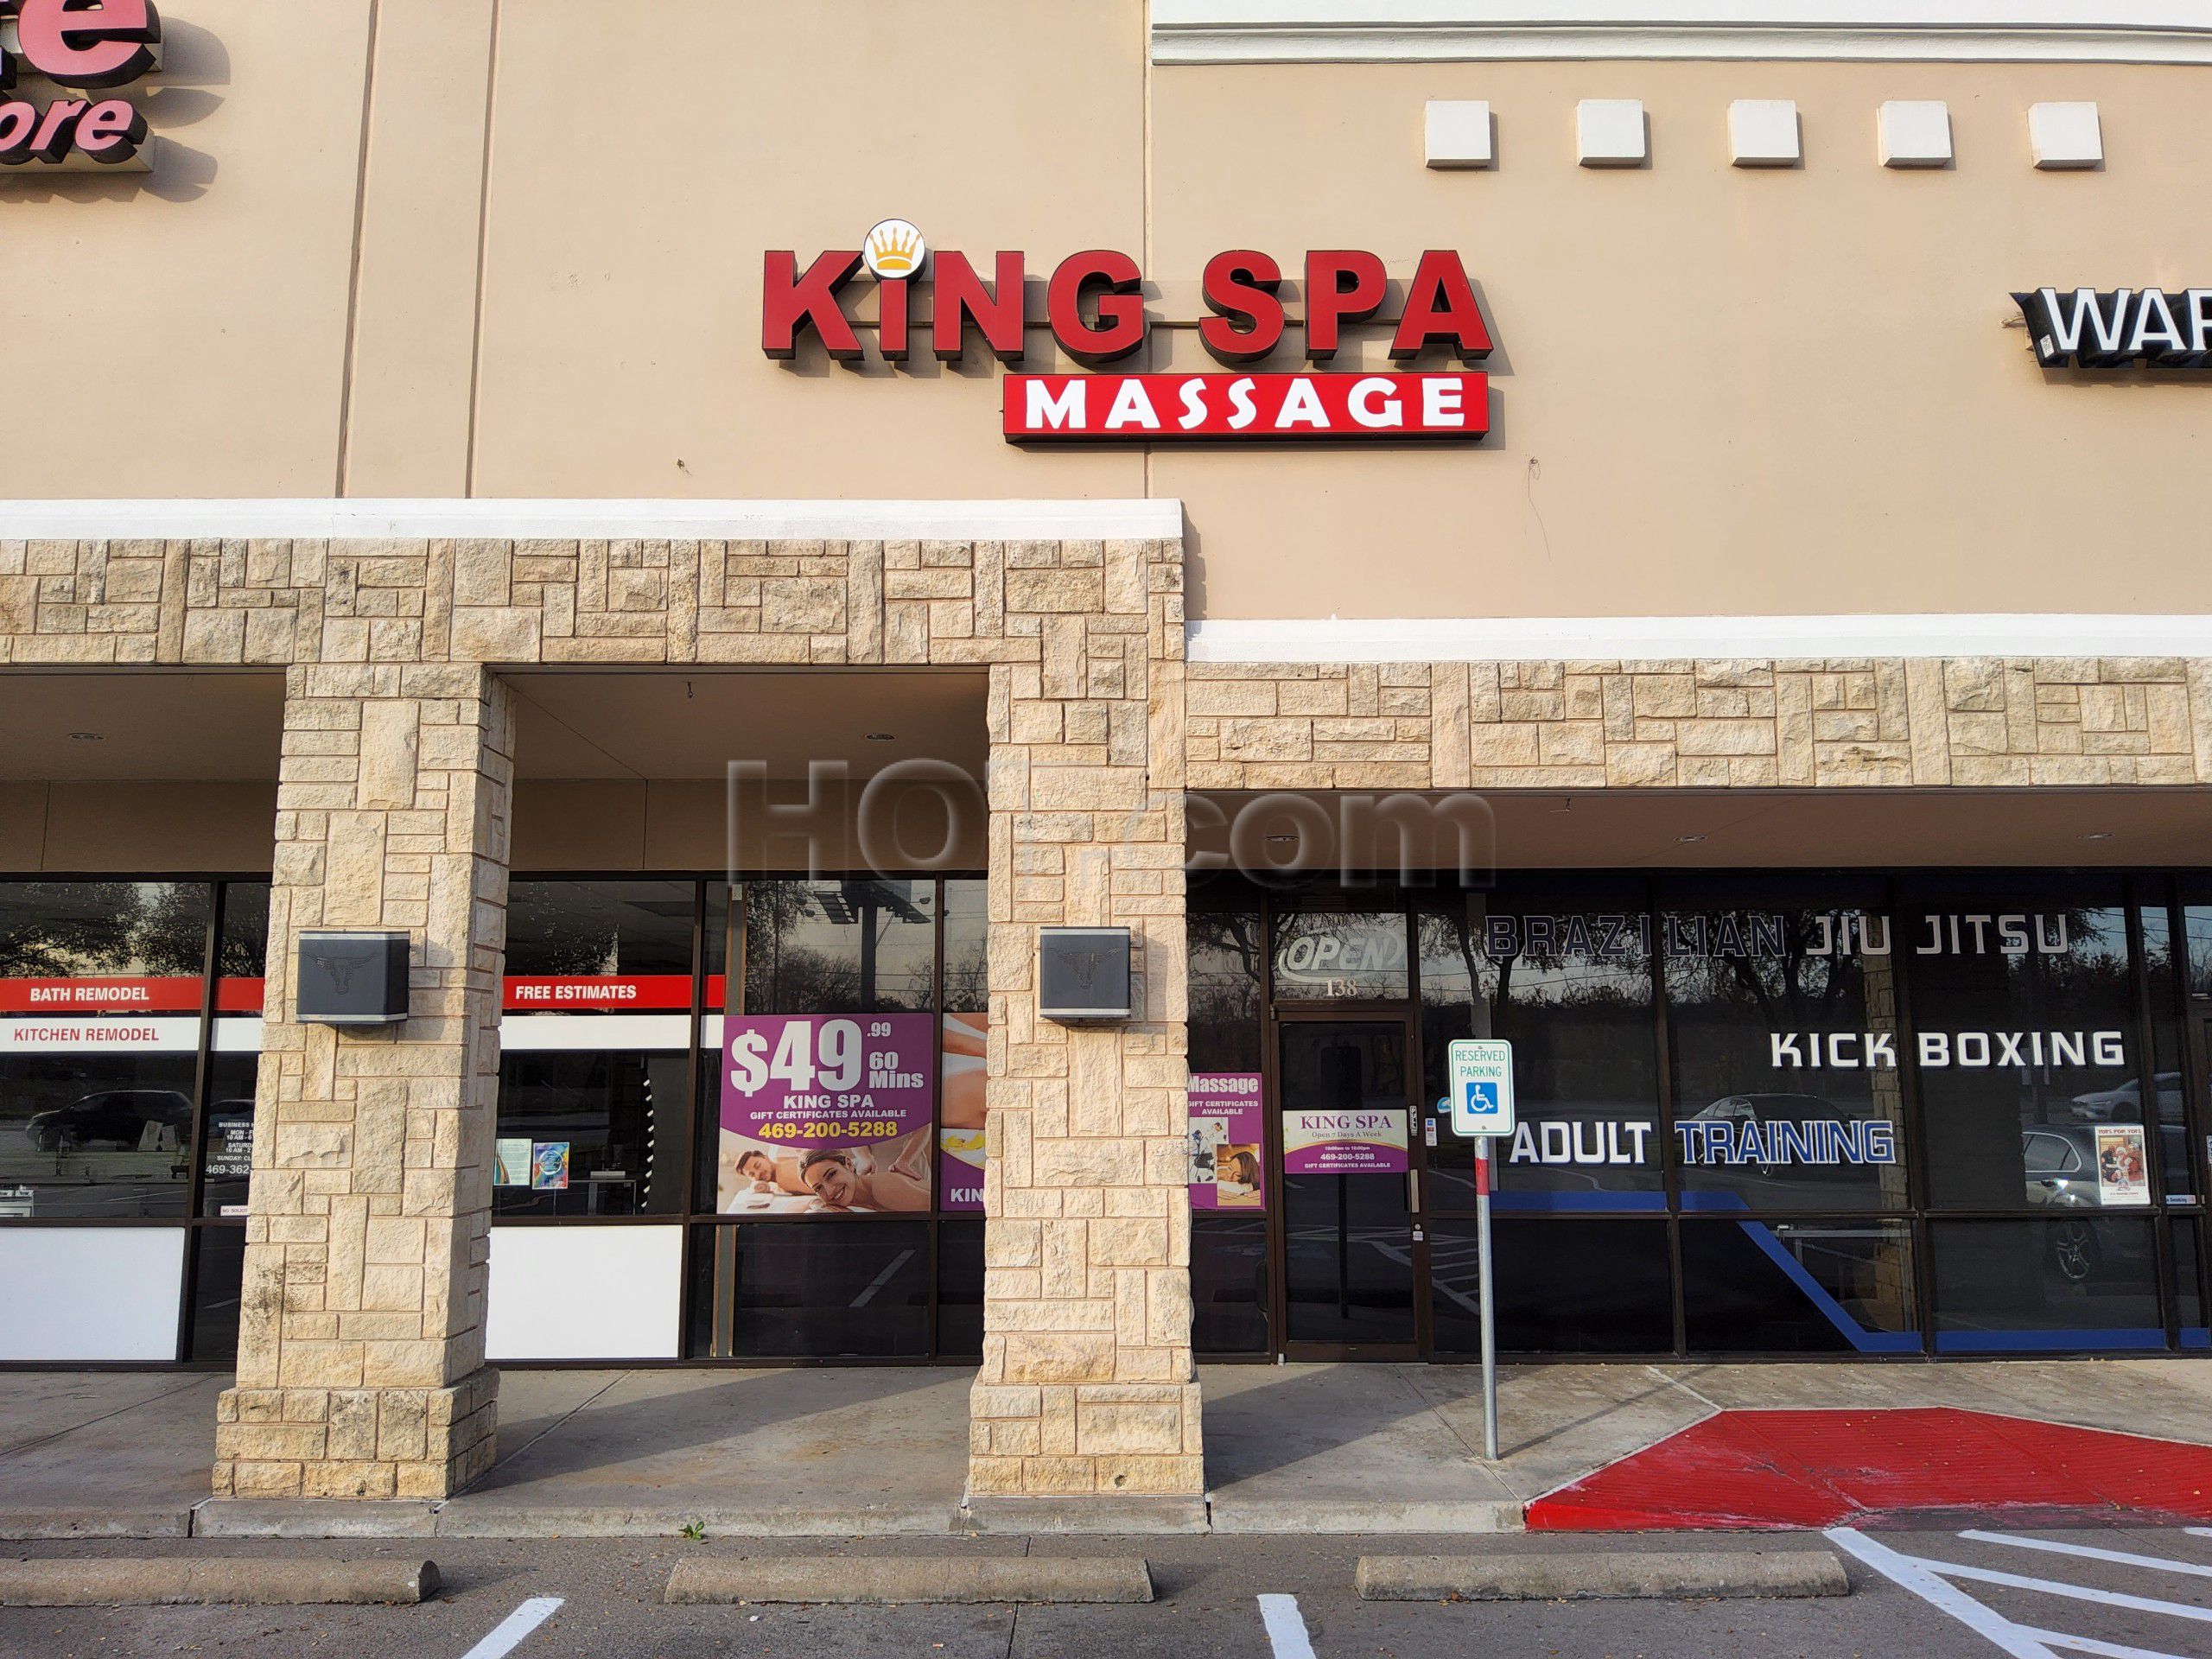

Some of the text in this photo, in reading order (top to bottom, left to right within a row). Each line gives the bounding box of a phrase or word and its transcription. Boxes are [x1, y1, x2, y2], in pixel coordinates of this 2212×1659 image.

[1198, 250, 1493, 358] SPA
[1026, 378, 1465, 429] MASSAGE
[1484, 914, 2069, 957] BRAZILIAN JIU JITSU
[1287, 936, 1390, 970] OPEN
[30, 987, 149, 1001] BATH REMODEL
[515, 984, 637, 1000] FREE ESTIMATES
[1325, 979, 1357, 996] 138
[14, 1027, 160, 1041] KITCHEN REMODEL
[1455, 1050, 1506, 1061] RESERVED
[1770, 1031, 2126, 1067] KICK BOXING
[730, 1019, 862, 1097] $49
[868, 1052, 899, 1070] 60
[868, 1070, 924, 1089] Mins
[1460, 1065, 1502, 1077] PARKING
[1188, 1076, 1259, 1095] Massage
[784, 1094, 874, 1109] KING SPA
[750, 1109, 907, 1120] GIFT CERTIFICATES AVAILABLE
[1300, 1115, 1393, 1129] KING SPA
[758, 1122, 899, 1139] 469-200-5288
[1509, 1120, 1897, 1166] ADULT TRAINING
